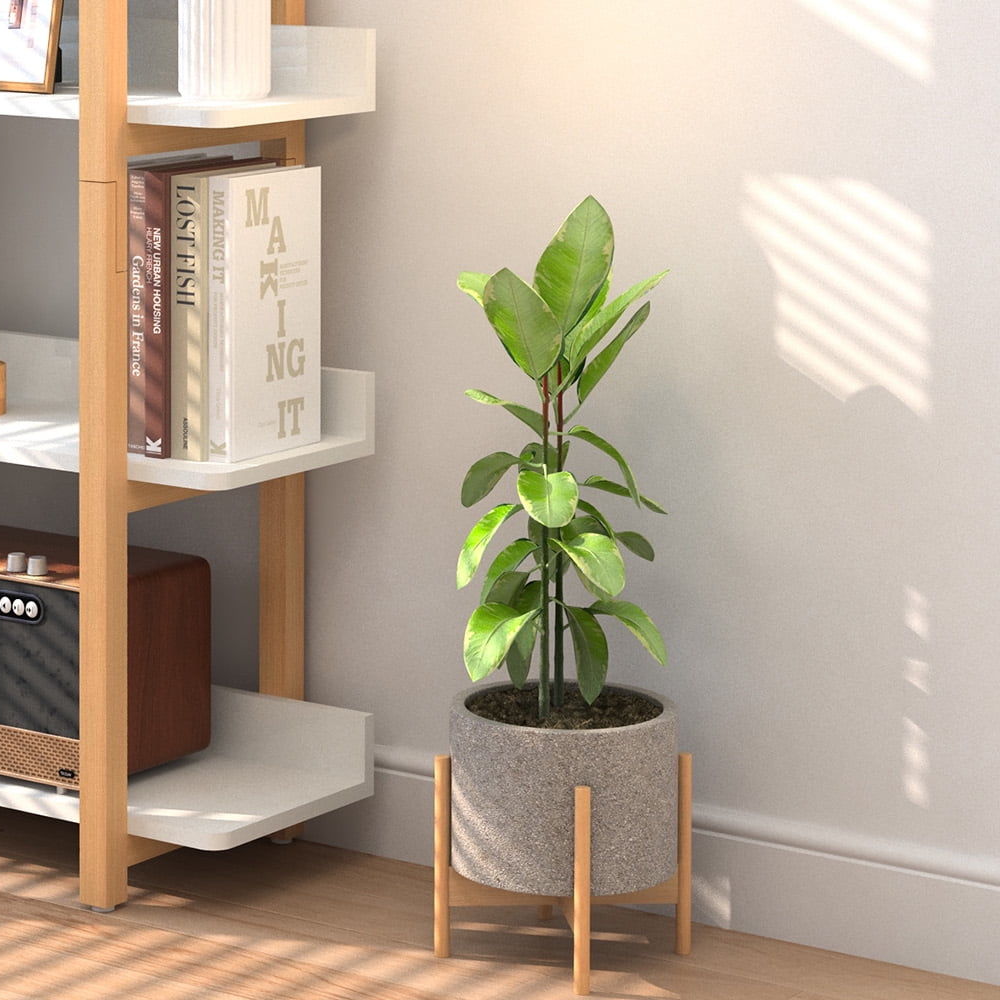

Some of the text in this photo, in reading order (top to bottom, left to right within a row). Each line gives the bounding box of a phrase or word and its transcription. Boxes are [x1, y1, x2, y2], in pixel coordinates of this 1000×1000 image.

[176, 185, 195, 307] LOST FISH
[212, 190, 225, 262] MAKING
[212, 264, 225, 285] IT
[131, 254, 144, 378] Gardens in France
[153, 227, 161, 335] NEW URBAN HOUSING
